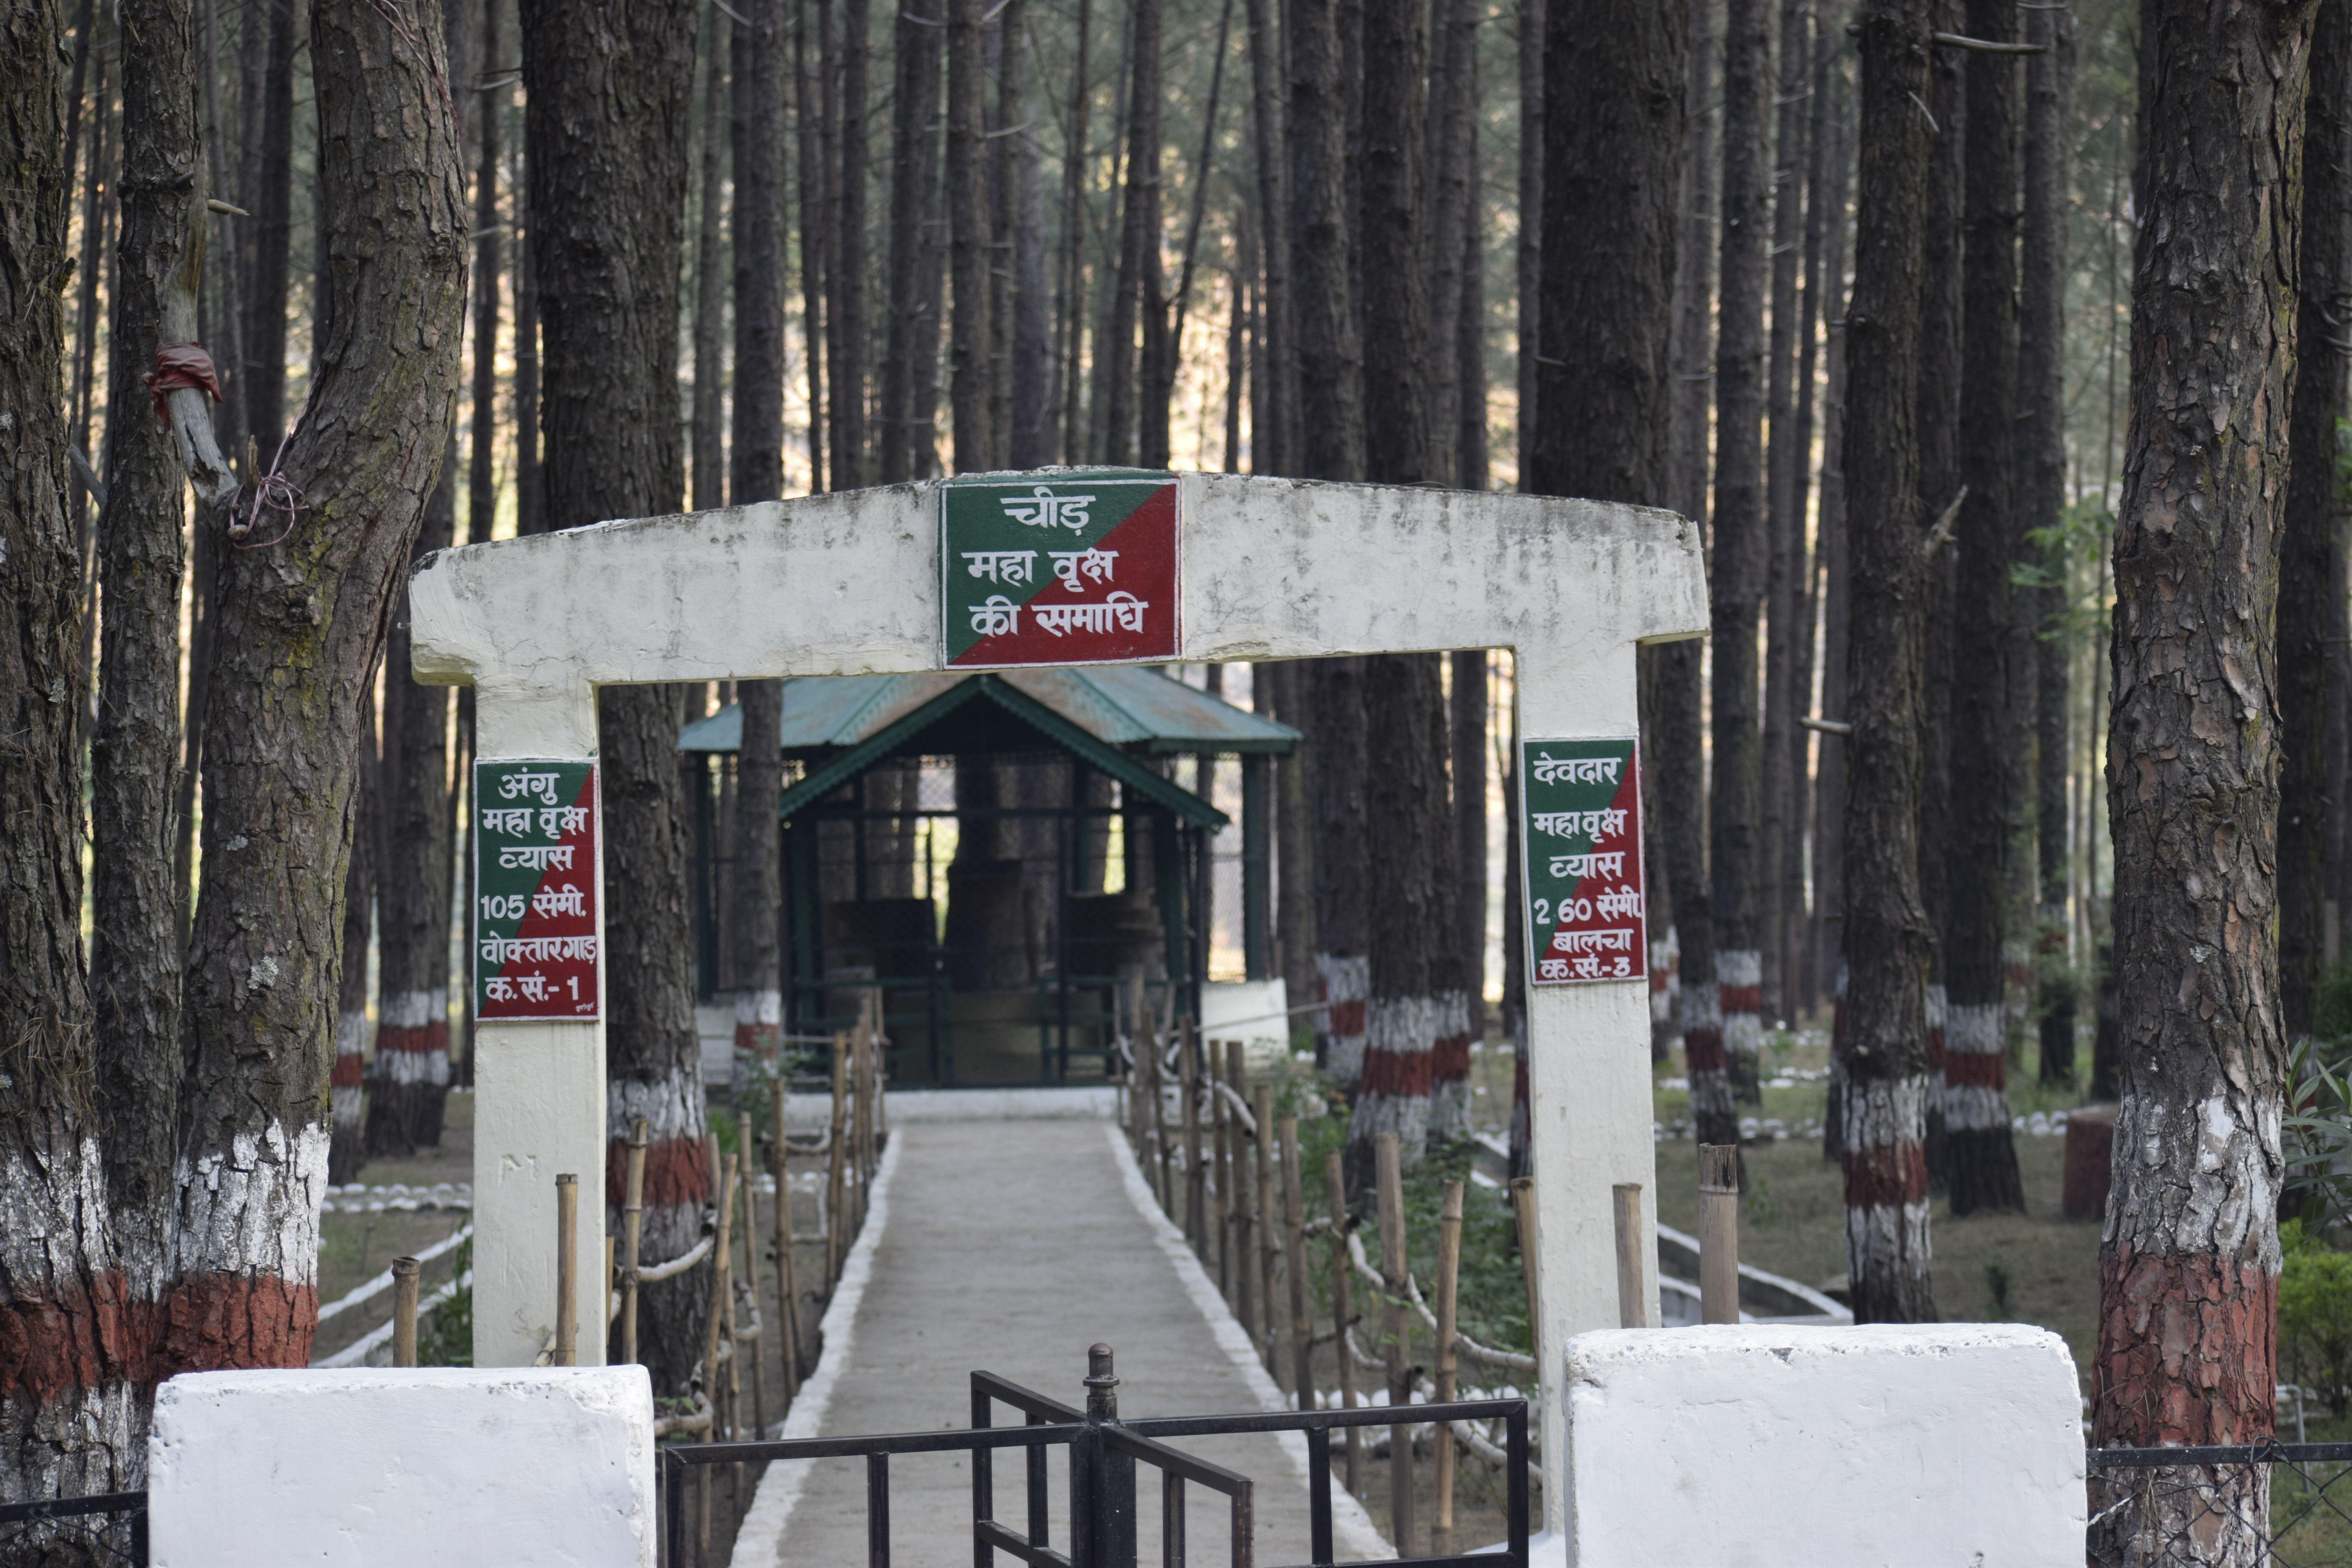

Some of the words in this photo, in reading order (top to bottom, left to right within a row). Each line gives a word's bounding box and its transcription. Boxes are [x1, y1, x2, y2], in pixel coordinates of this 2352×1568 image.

[1000, 486, 1096, 536] चीड़
[961, 550, 1038, 587] महा
[1047, 547, 1120, 592] वृक्ष
[968, 595, 1022, 637] की
[1031, 591, 1149, 637] समाधि
[498, 767, 560, 805] अंगु
[1533, 751, 1622, 786] देवदार
[482, 808, 534, 838] महा
[539, 805, 589, 840] वृक्ष
[499, 845, 575, 871] व्यास
[1549, 851, 1626, 881] व्यास
[481, 895, 525, 920] 105
[1553, 928, 1634, 953] बालचा
